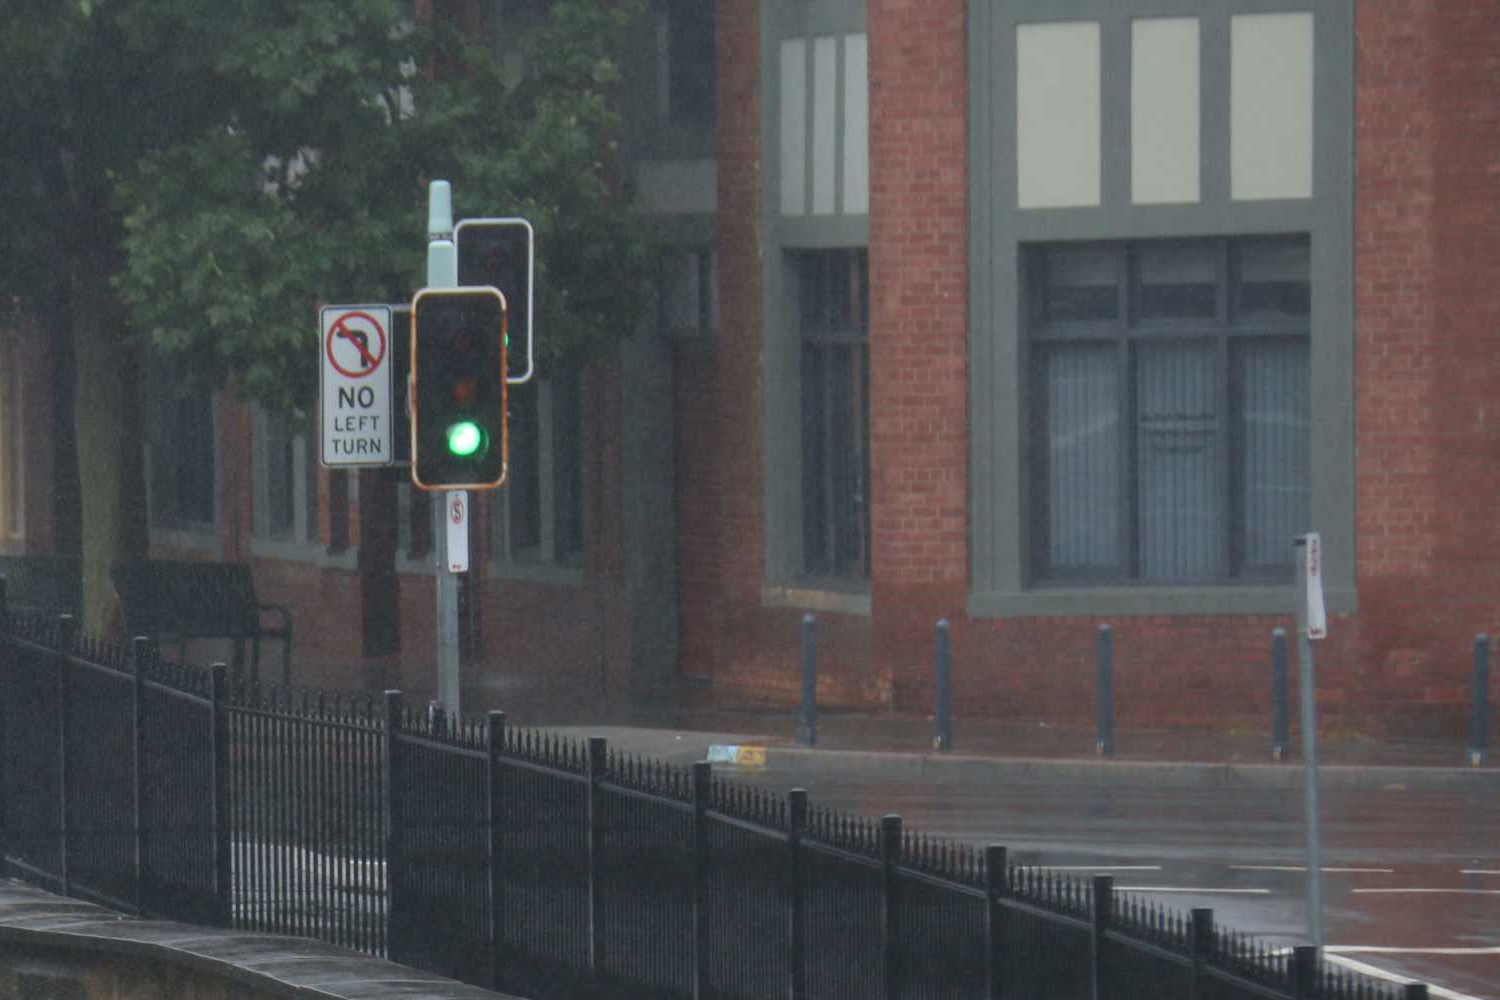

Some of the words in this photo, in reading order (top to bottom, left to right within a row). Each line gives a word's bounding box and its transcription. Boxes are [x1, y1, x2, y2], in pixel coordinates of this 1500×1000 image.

[338, 386, 375, 409] NO
[334, 416, 380, 432] LEFT
[332, 439, 381, 455] TURN
